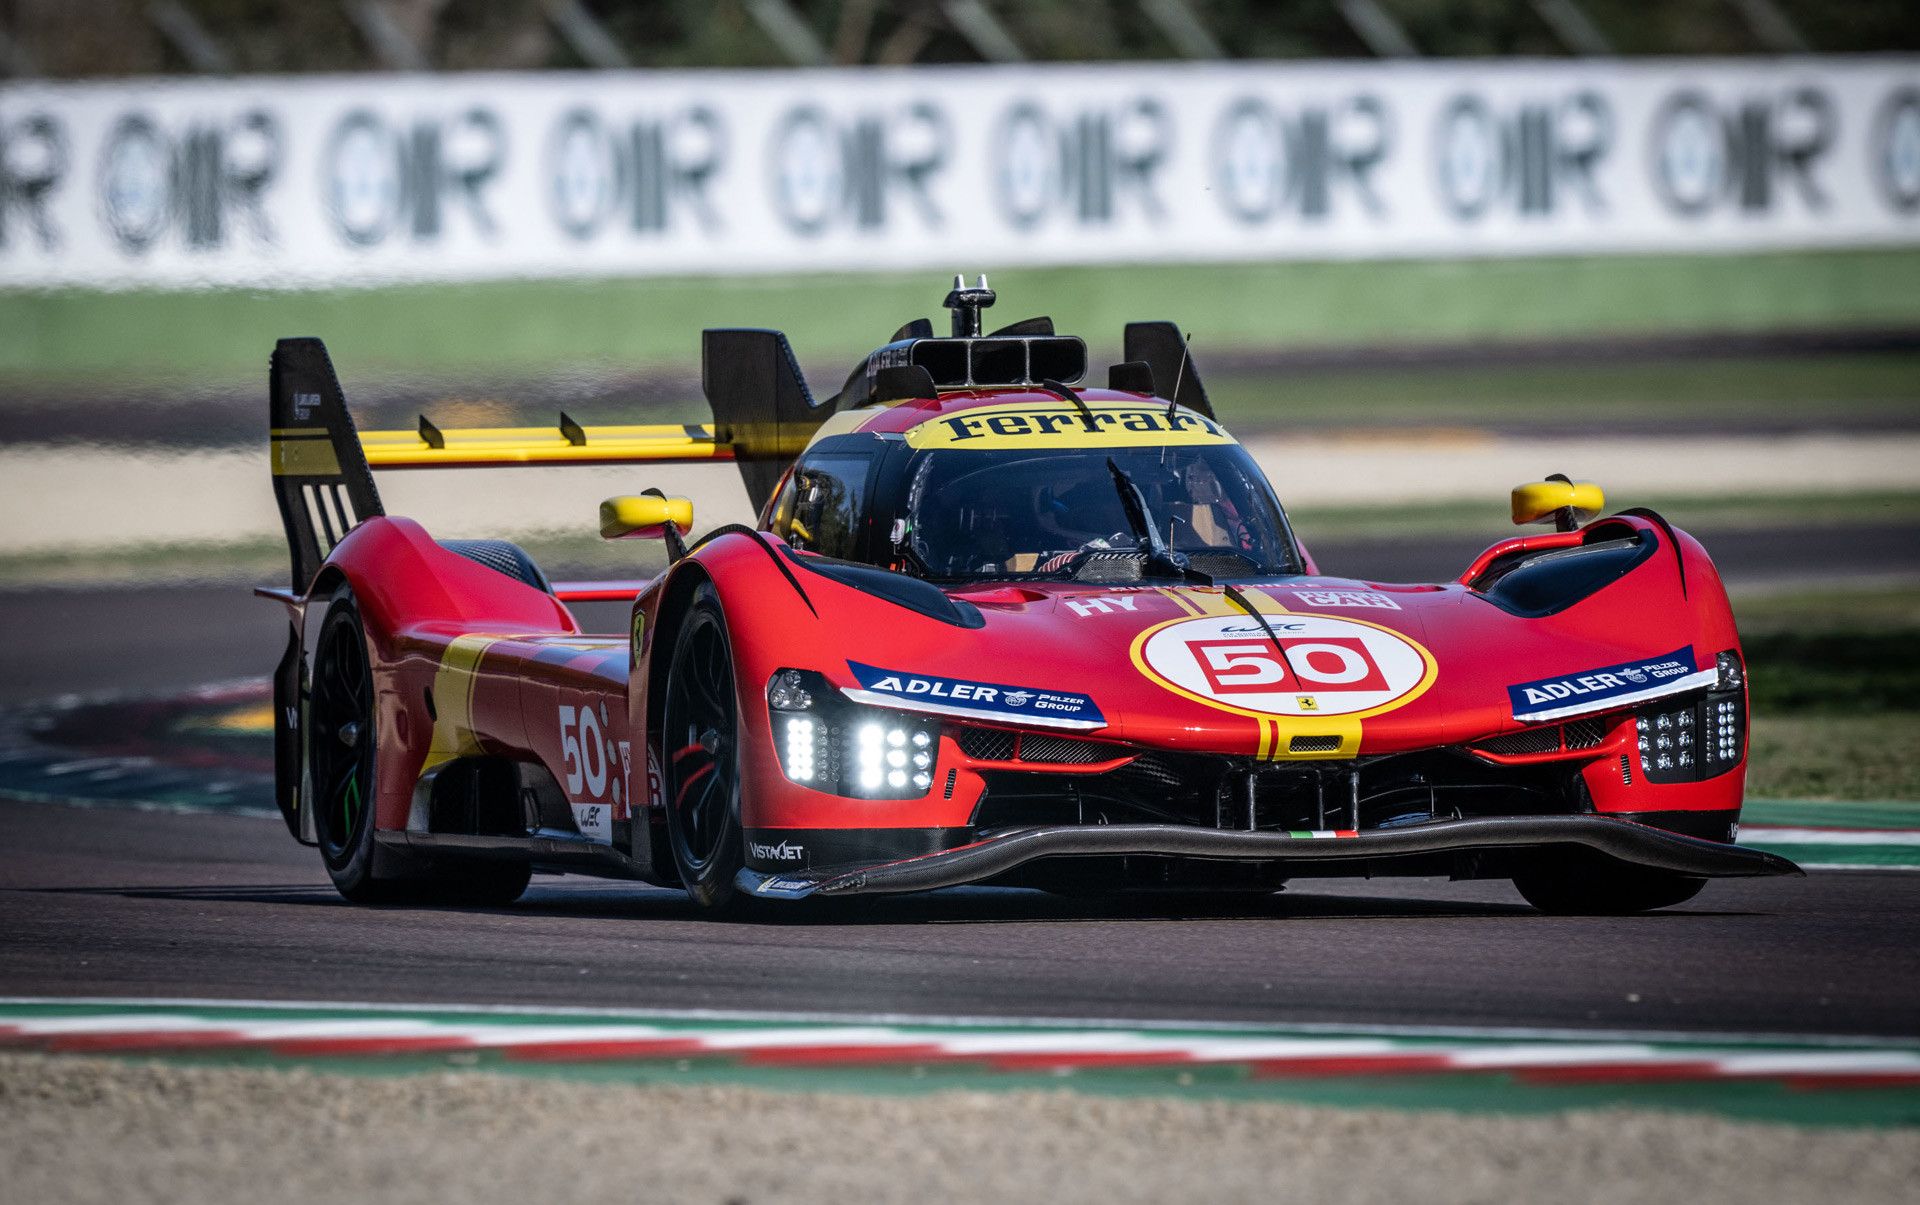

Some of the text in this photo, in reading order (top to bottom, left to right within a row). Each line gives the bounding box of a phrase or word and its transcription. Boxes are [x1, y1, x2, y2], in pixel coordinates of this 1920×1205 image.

[940, 409, 1224, 442] Ferrari
[1064, 595, 1138, 617] HY
[1200, 643, 1370, 686] 50
[1644, 661, 1682, 673] PELZER
[1653, 665, 1689, 678] GROUP
[870, 676, 998, 702] ADLER
[1038, 693, 1085, 705] PELZER
[1522, 673, 1626, 705] ADLER
[1034, 700, 1081, 712] GROUP
[558, 705, 607, 798] 50
